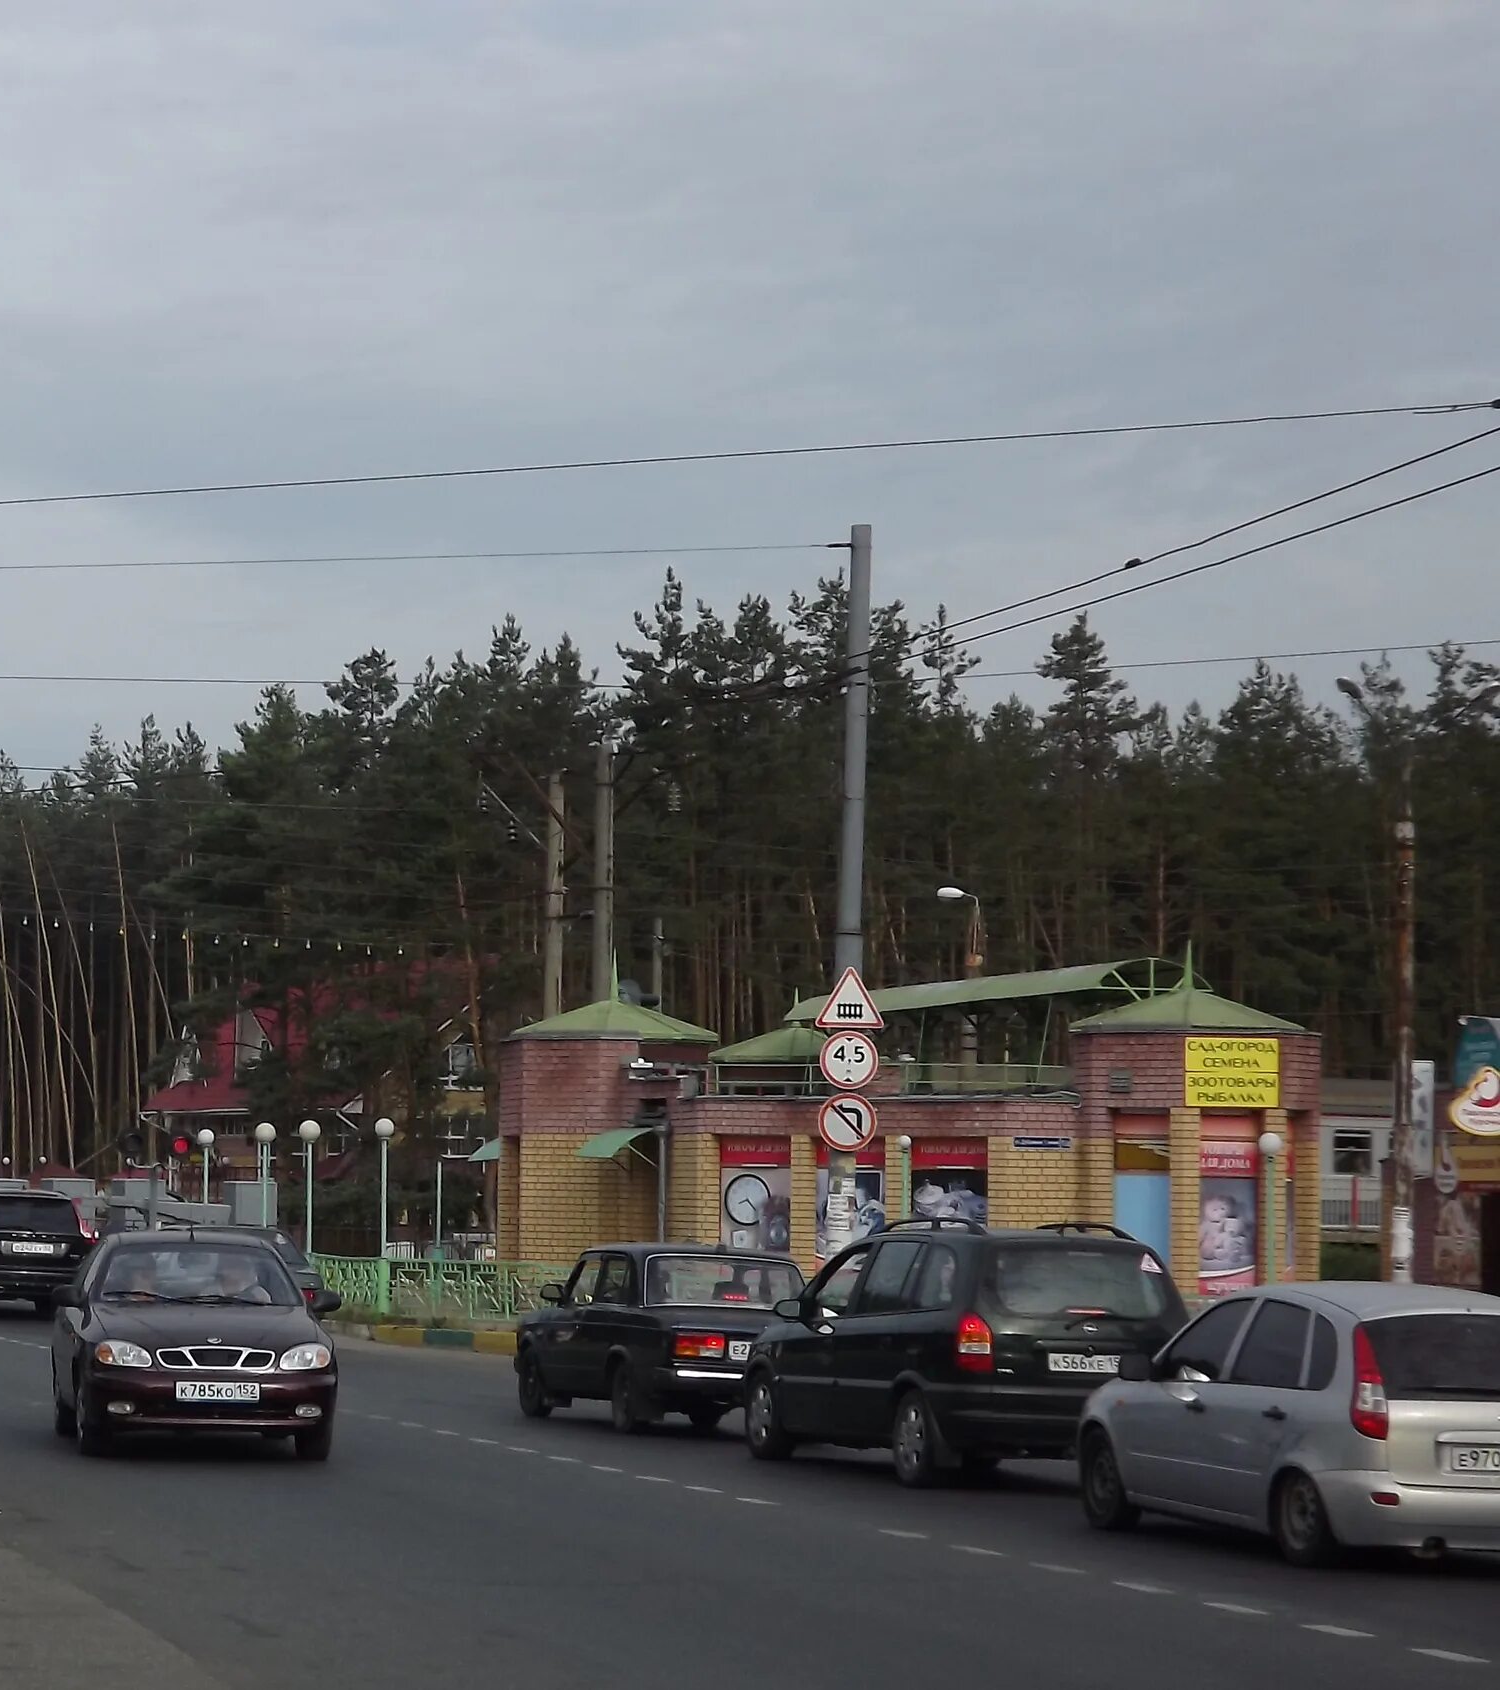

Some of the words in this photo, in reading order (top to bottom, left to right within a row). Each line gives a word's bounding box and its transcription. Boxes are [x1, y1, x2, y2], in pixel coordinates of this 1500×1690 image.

[1187, 1040, 1277, 1053] САД-ОГОРОД
[833, 1045, 865, 1063] 4,5
[1202, 1057, 1261, 1068] СЕМЕНА
[1187, 1076, 1277, 1088] ЗООТОВАРЫ
[1197, 1092, 1266, 1103] РЫБАЛКА
[732, 1343, 751, 1355] Е2
[180, 1384, 234, 1398] К785КО
[236, 1384, 257, 1396] 152
